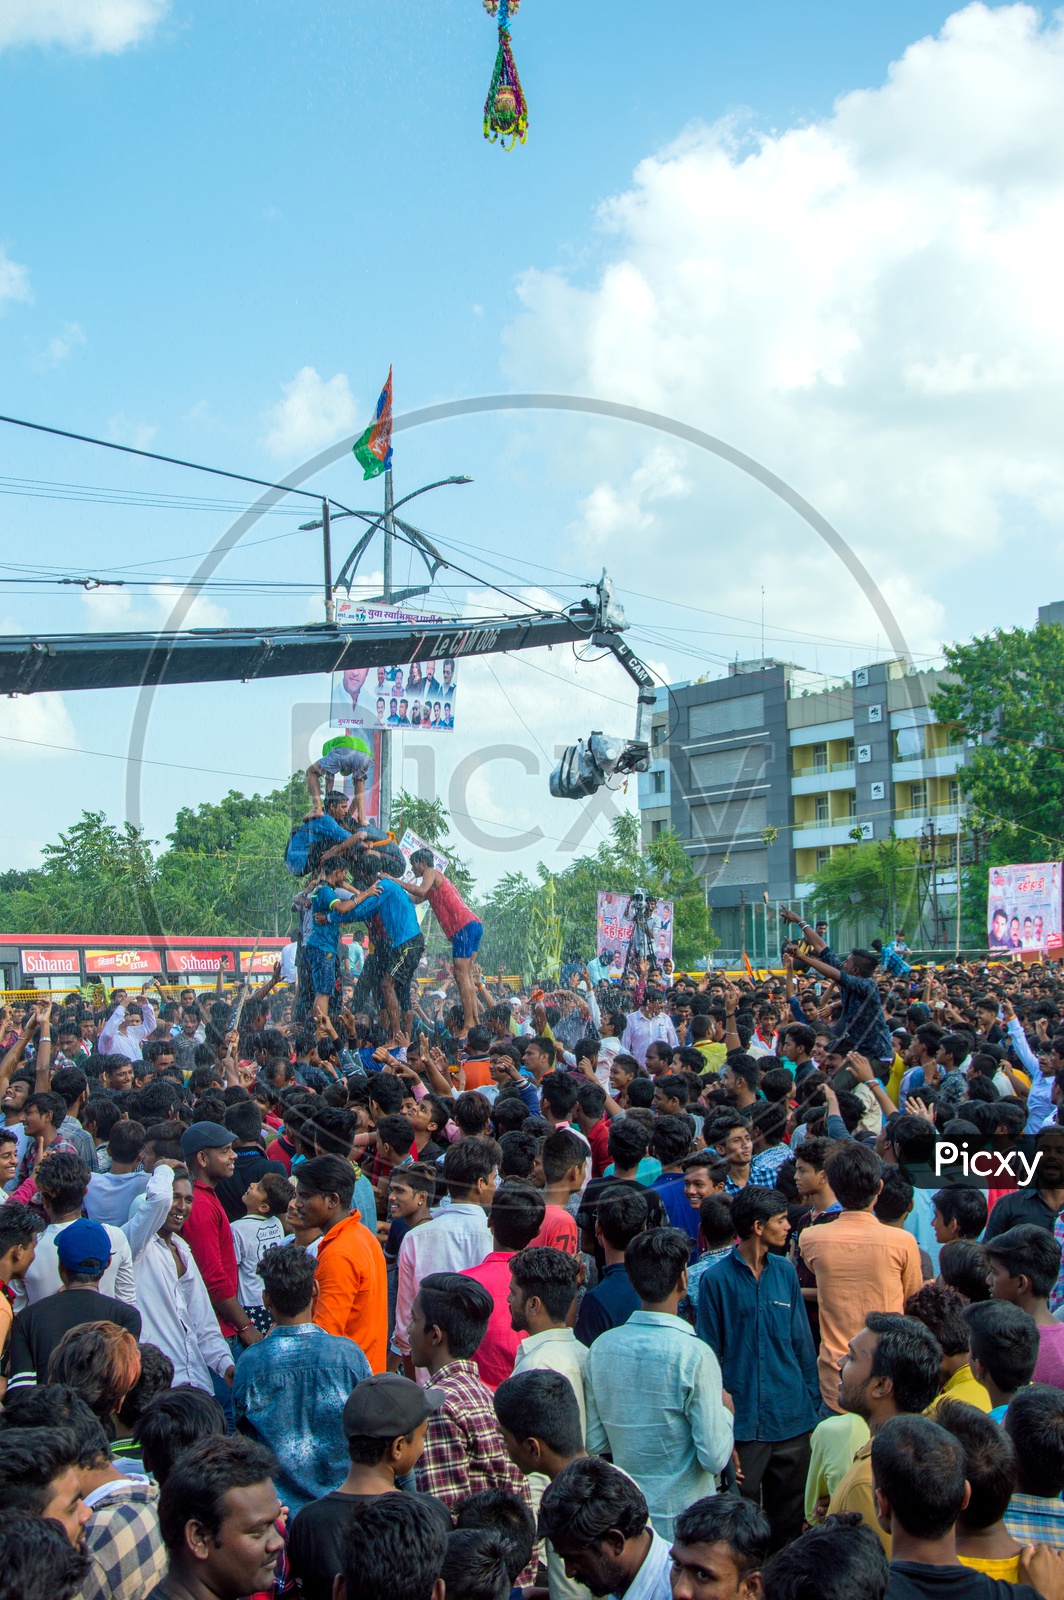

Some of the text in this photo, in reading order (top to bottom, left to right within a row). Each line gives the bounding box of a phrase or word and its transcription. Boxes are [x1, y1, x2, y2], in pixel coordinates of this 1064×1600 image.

[449, 630, 480, 655] CAM
[475, 628, 501, 652] 006
[628, 658, 648, 681] CAM
[27, 953, 73, 972] Suhana
[115, 951, 140, 967] 50%
[130, 961, 149, 970] EXTRA
[180, 953, 220, 971] Suhana
